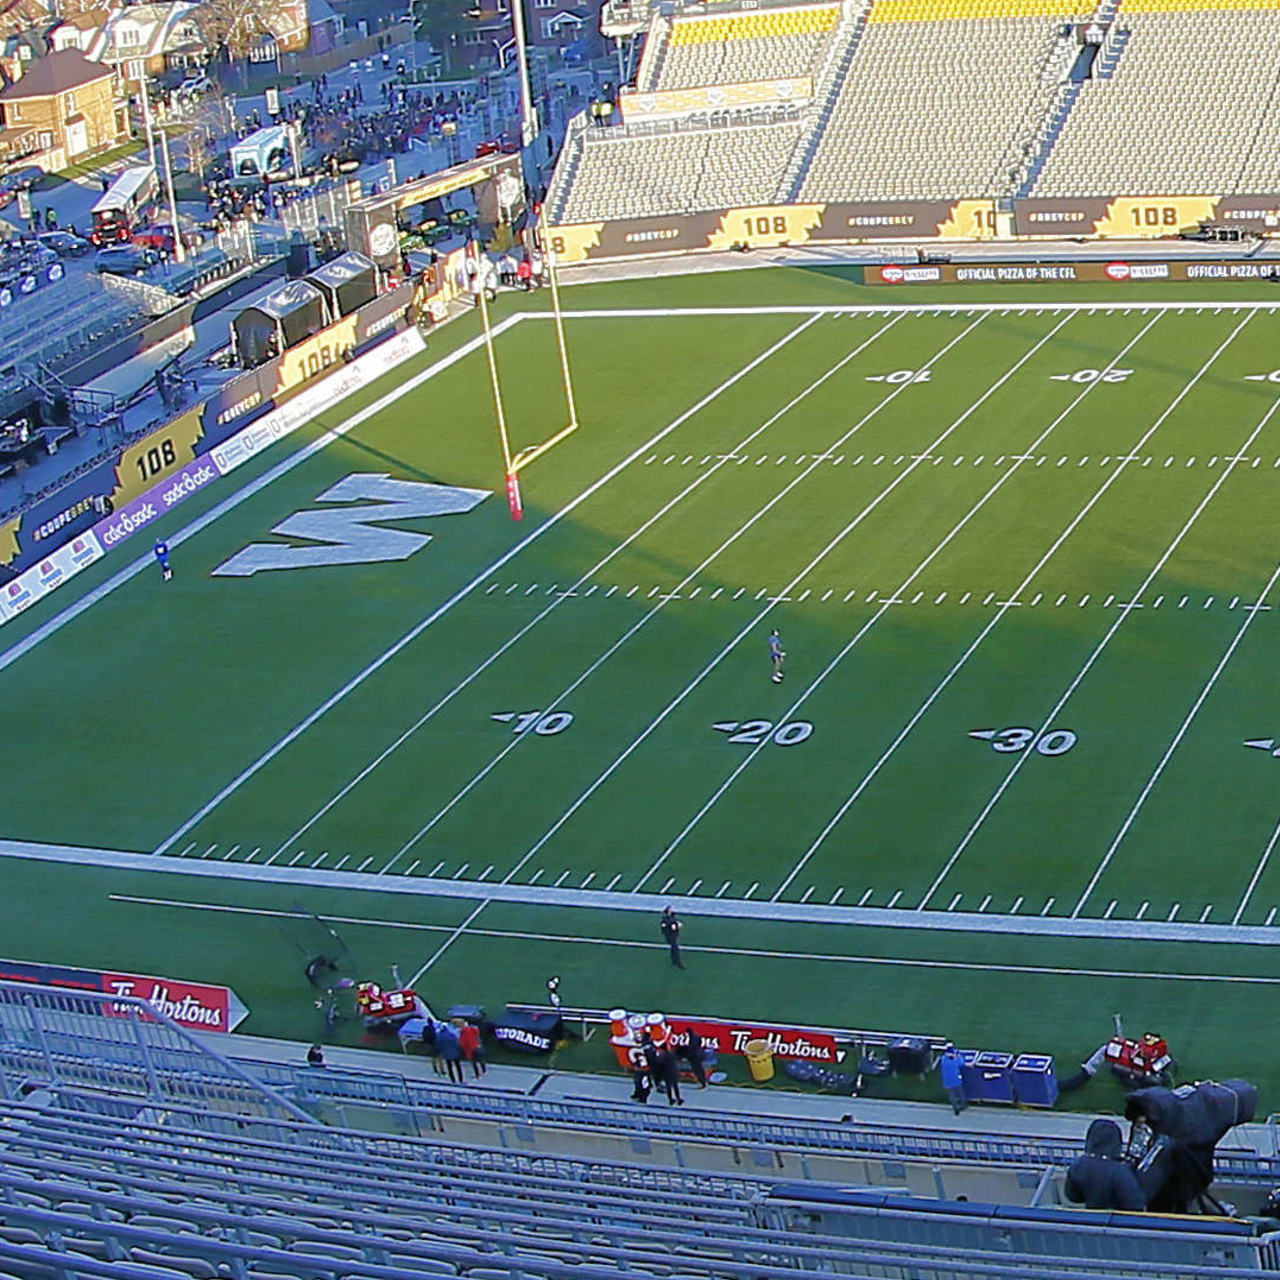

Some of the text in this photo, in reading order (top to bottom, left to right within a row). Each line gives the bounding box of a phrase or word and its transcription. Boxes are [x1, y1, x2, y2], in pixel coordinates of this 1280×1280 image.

[743, 216, 787, 236] 108
[1130, 206, 1177, 226] 108
[957, 267, 1076, 280] OFFICIAL PIZZA OF THE CFL
[1187, 264, 1229, 278] OFFICIAL
[1230, 265, 1259, 278] PIZZA
[1260, 265, 1273, 277] OF
[298, 344, 332, 380] 108
[883, 368, 934, 385] 10
[1070, 368, 1136, 384] 20
[136, 438, 176, 482] 108
[511, 711, 574, 736] 10
[727, 720, 815, 747] 20
[991, 727, 1078, 757] 30
[149, 984, 222, 1026] Hortons
[764, 1032, 832, 1060] Hortons
